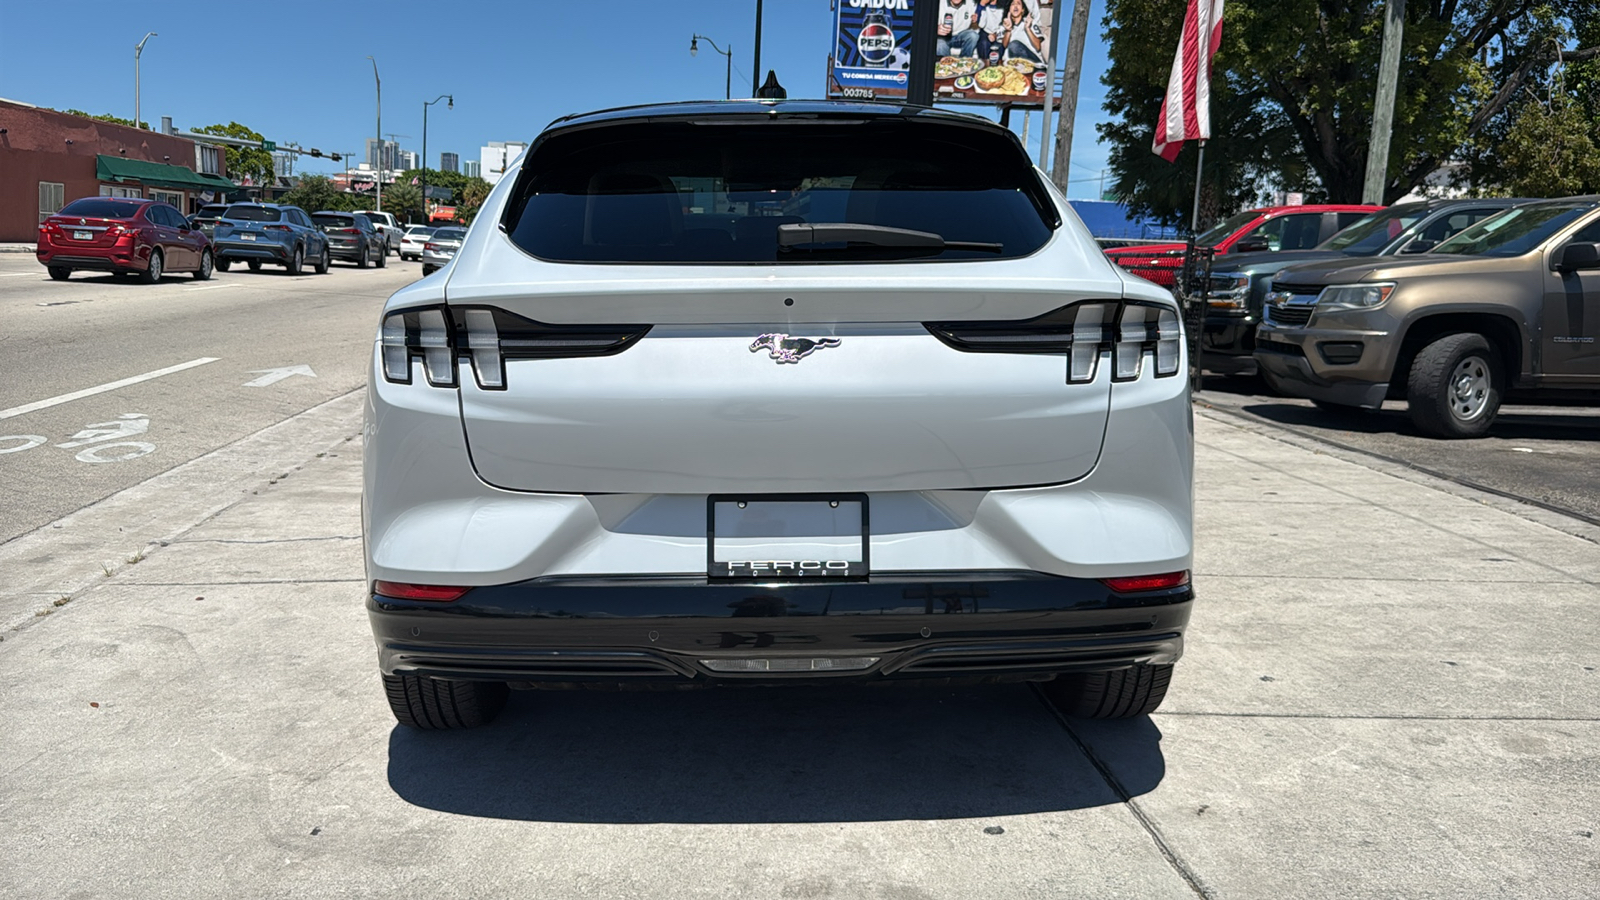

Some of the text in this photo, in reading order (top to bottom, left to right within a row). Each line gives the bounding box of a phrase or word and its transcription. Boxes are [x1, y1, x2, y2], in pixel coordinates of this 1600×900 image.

[860, 38, 892, 48] PEPSI
[844, 88, 873, 98] 003785
[728, 560, 849, 570] FERCO
